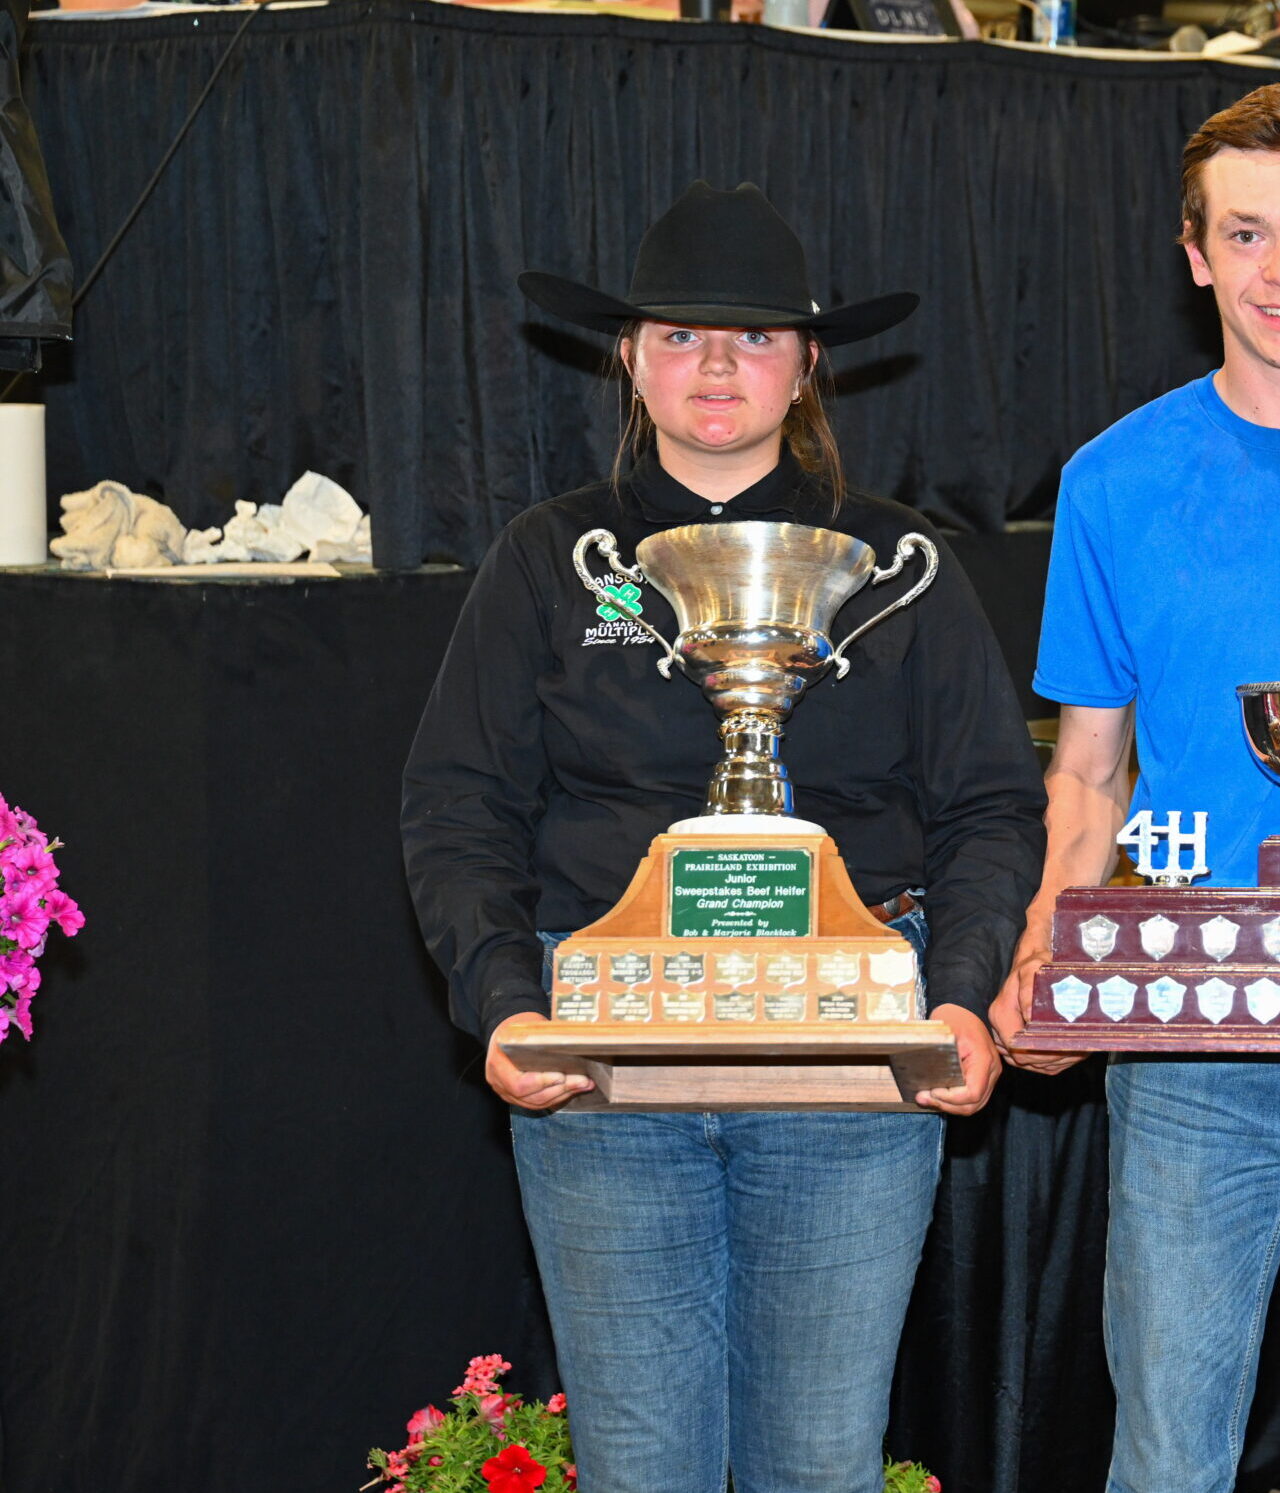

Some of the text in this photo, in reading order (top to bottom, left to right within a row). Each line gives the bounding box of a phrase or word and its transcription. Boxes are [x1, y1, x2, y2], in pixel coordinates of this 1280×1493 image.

[581, 637, 617, 647] Since
[718, 853, 764, 861] SASKATOON
[685, 863, 797, 871] PRAIRIELAND EXHIBITION
[724, 874, 757, 884] Junior
[675, 886, 806, 898] Sweepstakes Beef Heifer
[696, 898, 784, 911] Grand Champion
[711, 919, 769, 928] Presented by
[683, 929, 698, 937] Bob
[701, 929, 709, 937] &
[713, 929, 752, 937] Marjorie
